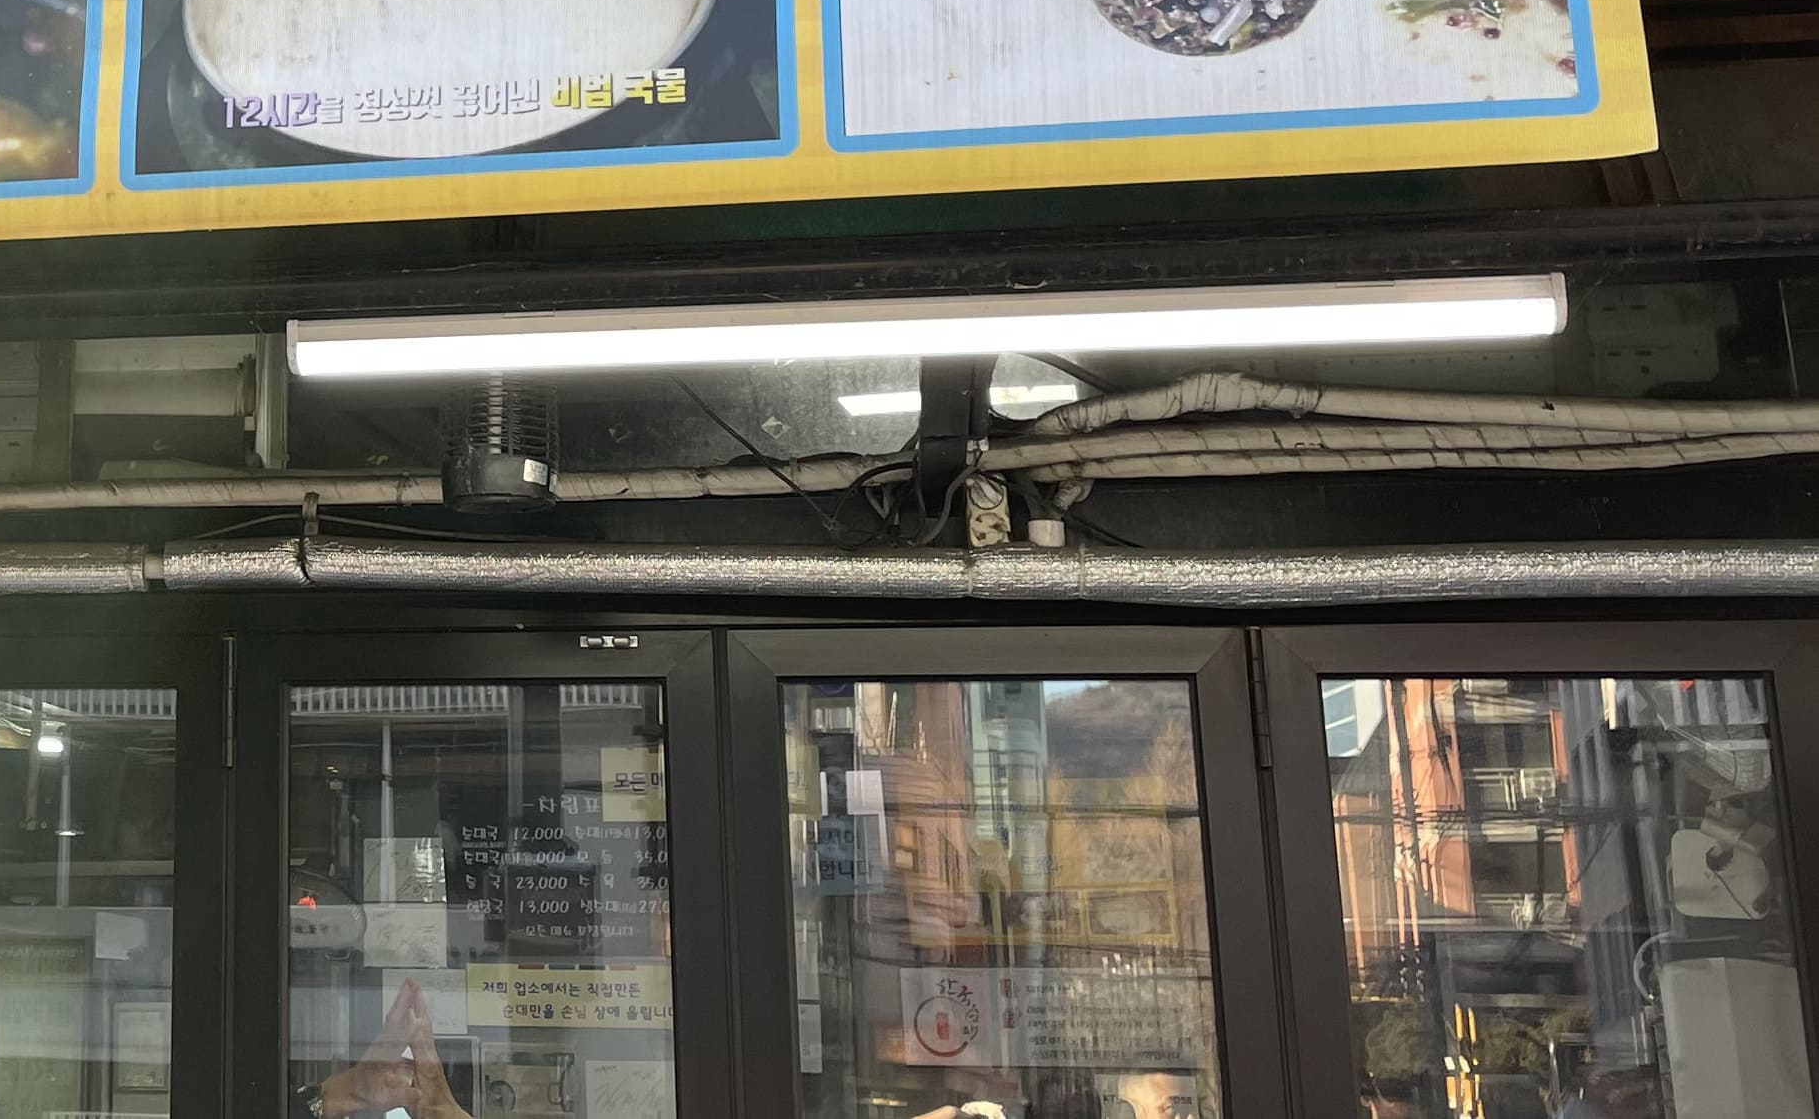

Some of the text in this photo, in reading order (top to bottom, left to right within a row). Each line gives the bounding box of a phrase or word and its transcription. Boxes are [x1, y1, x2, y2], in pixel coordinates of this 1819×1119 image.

[223, 91, 344, 129] 12시간을
[354, 85, 444, 123] 정성껏
[625, 67, 687, 105] 국물
[613, 772, 647, 795] 모든
[513, 826, 565, 842] 12,000
[515, 876, 568, 891] 23,000
[520, 899, 570, 915] 13,000
[482, 981, 642, 999] 저희 업소에서는 직접만든
[561, 1004, 587, 1020] 손님
